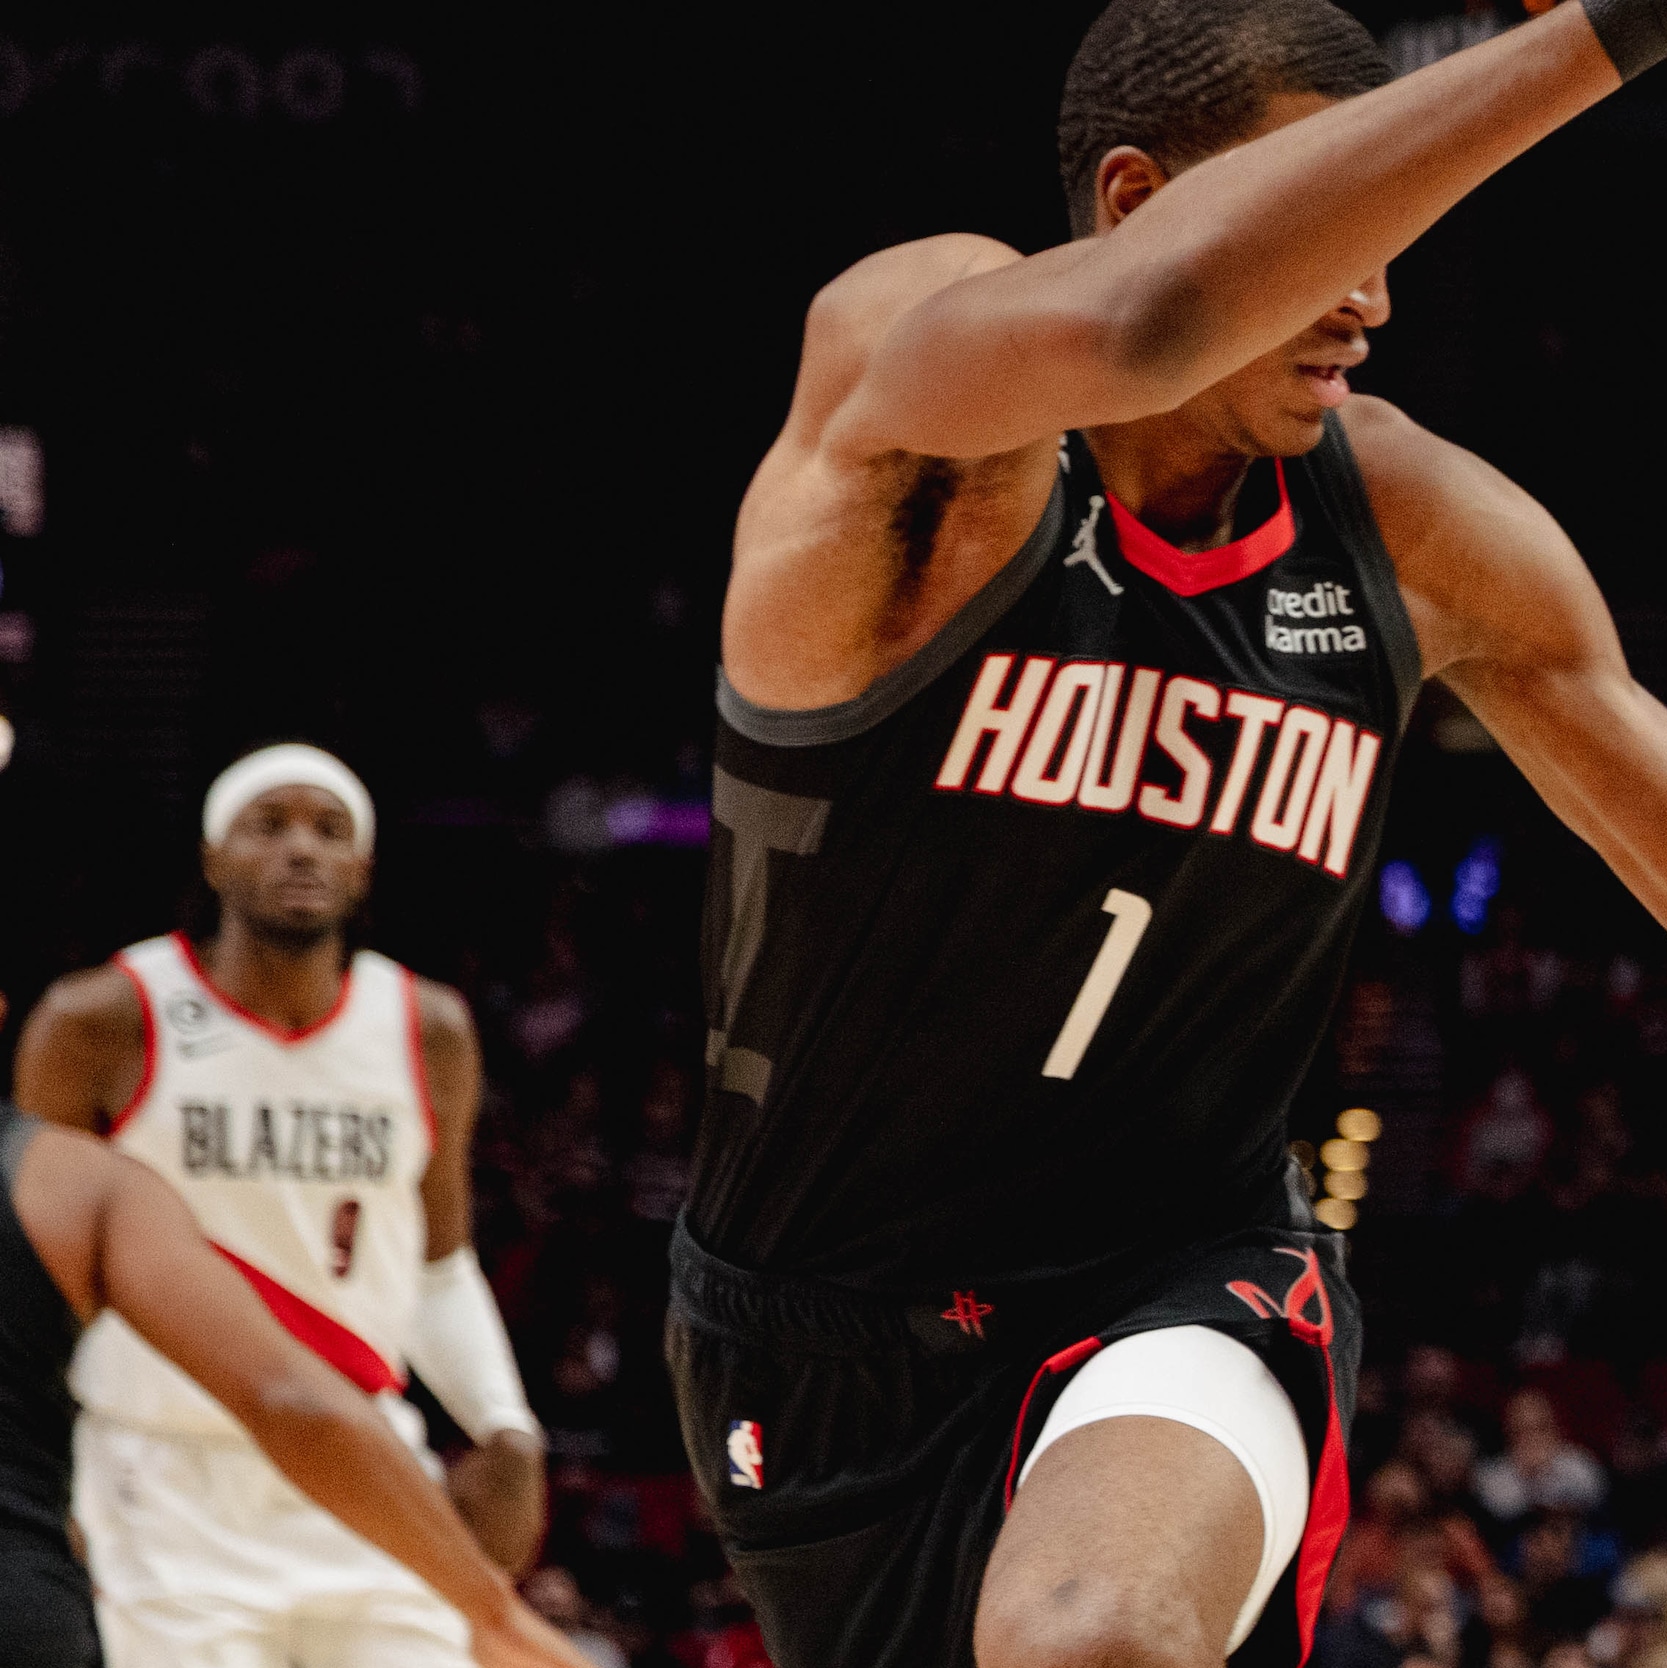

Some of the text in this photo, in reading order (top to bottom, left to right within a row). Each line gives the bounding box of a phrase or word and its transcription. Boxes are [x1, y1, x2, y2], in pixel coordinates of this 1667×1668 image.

[933, 653, 1382, 879] HOUSTON
[1041, 887, 1153, 1080] 1
[177, 1099, 394, 1183] BLAZERS
